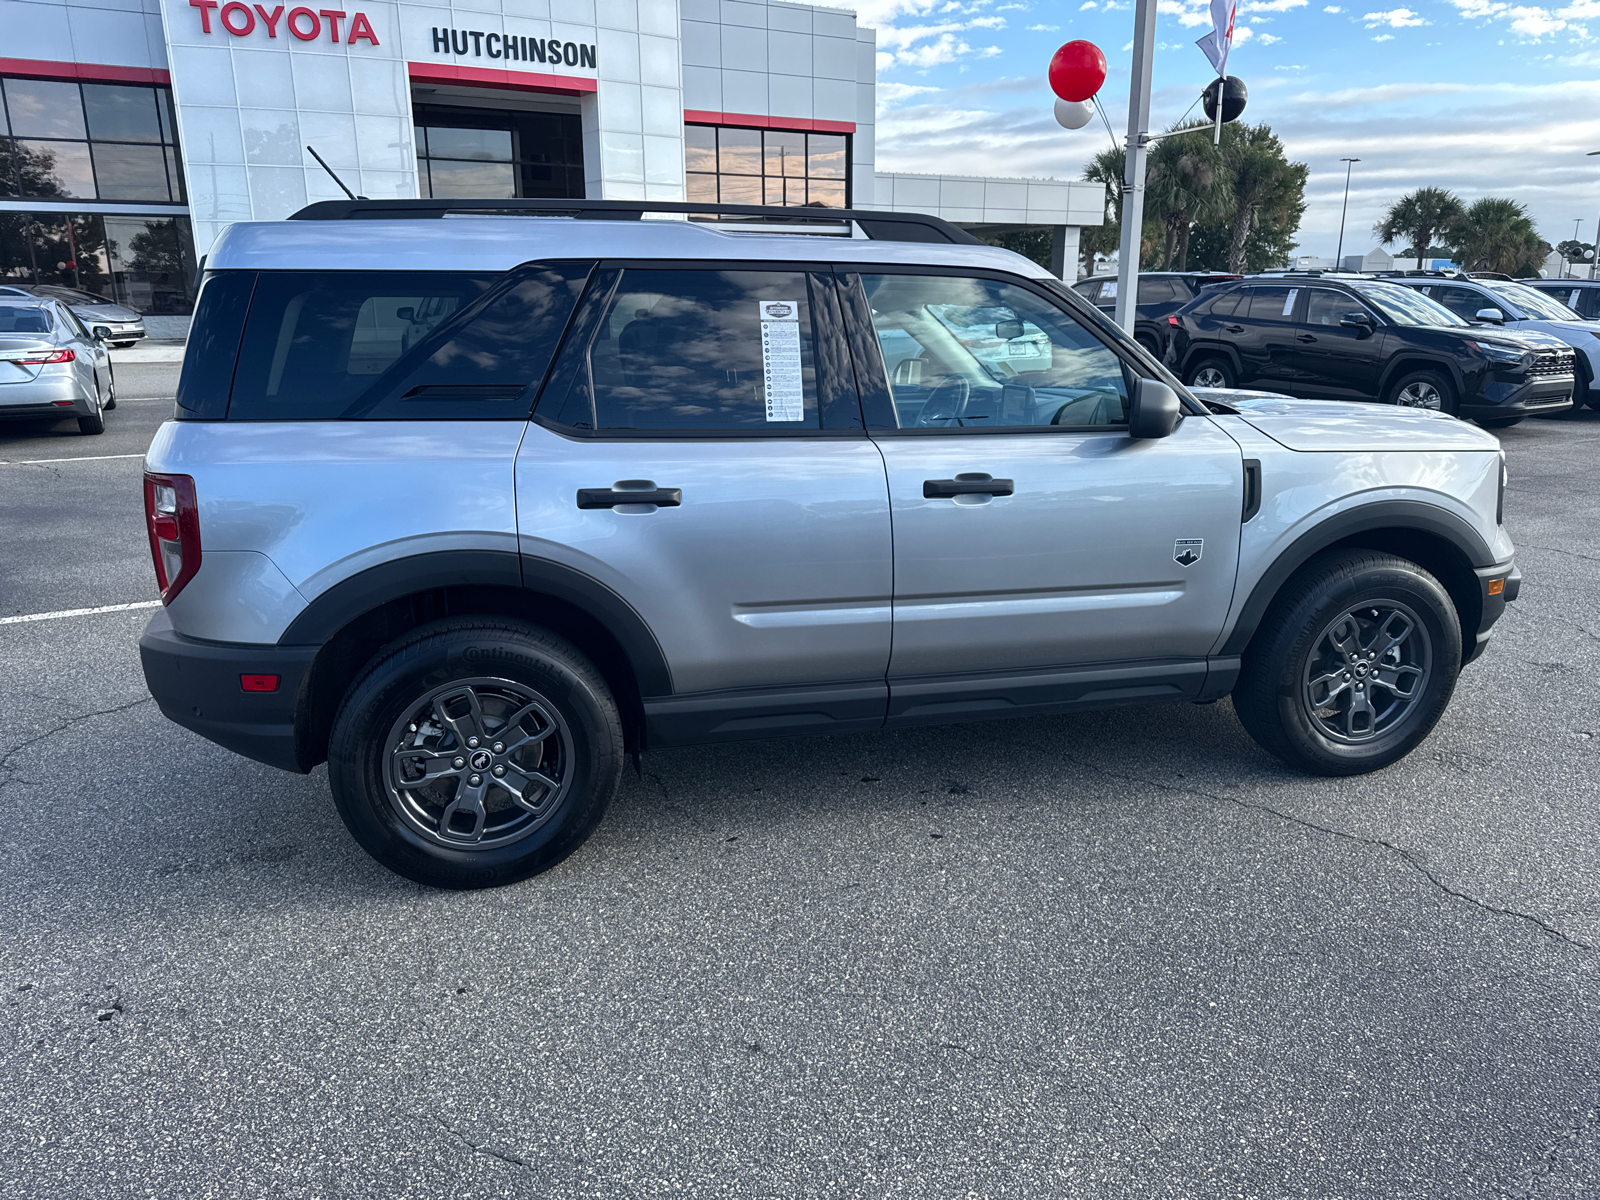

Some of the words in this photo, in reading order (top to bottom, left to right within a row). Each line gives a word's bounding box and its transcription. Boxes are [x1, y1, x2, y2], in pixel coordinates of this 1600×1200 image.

[189, 0, 380, 46] TOYOTA
[431, 26, 598, 69] HUTCHINSON
[461, 645, 555, 673] Continental
